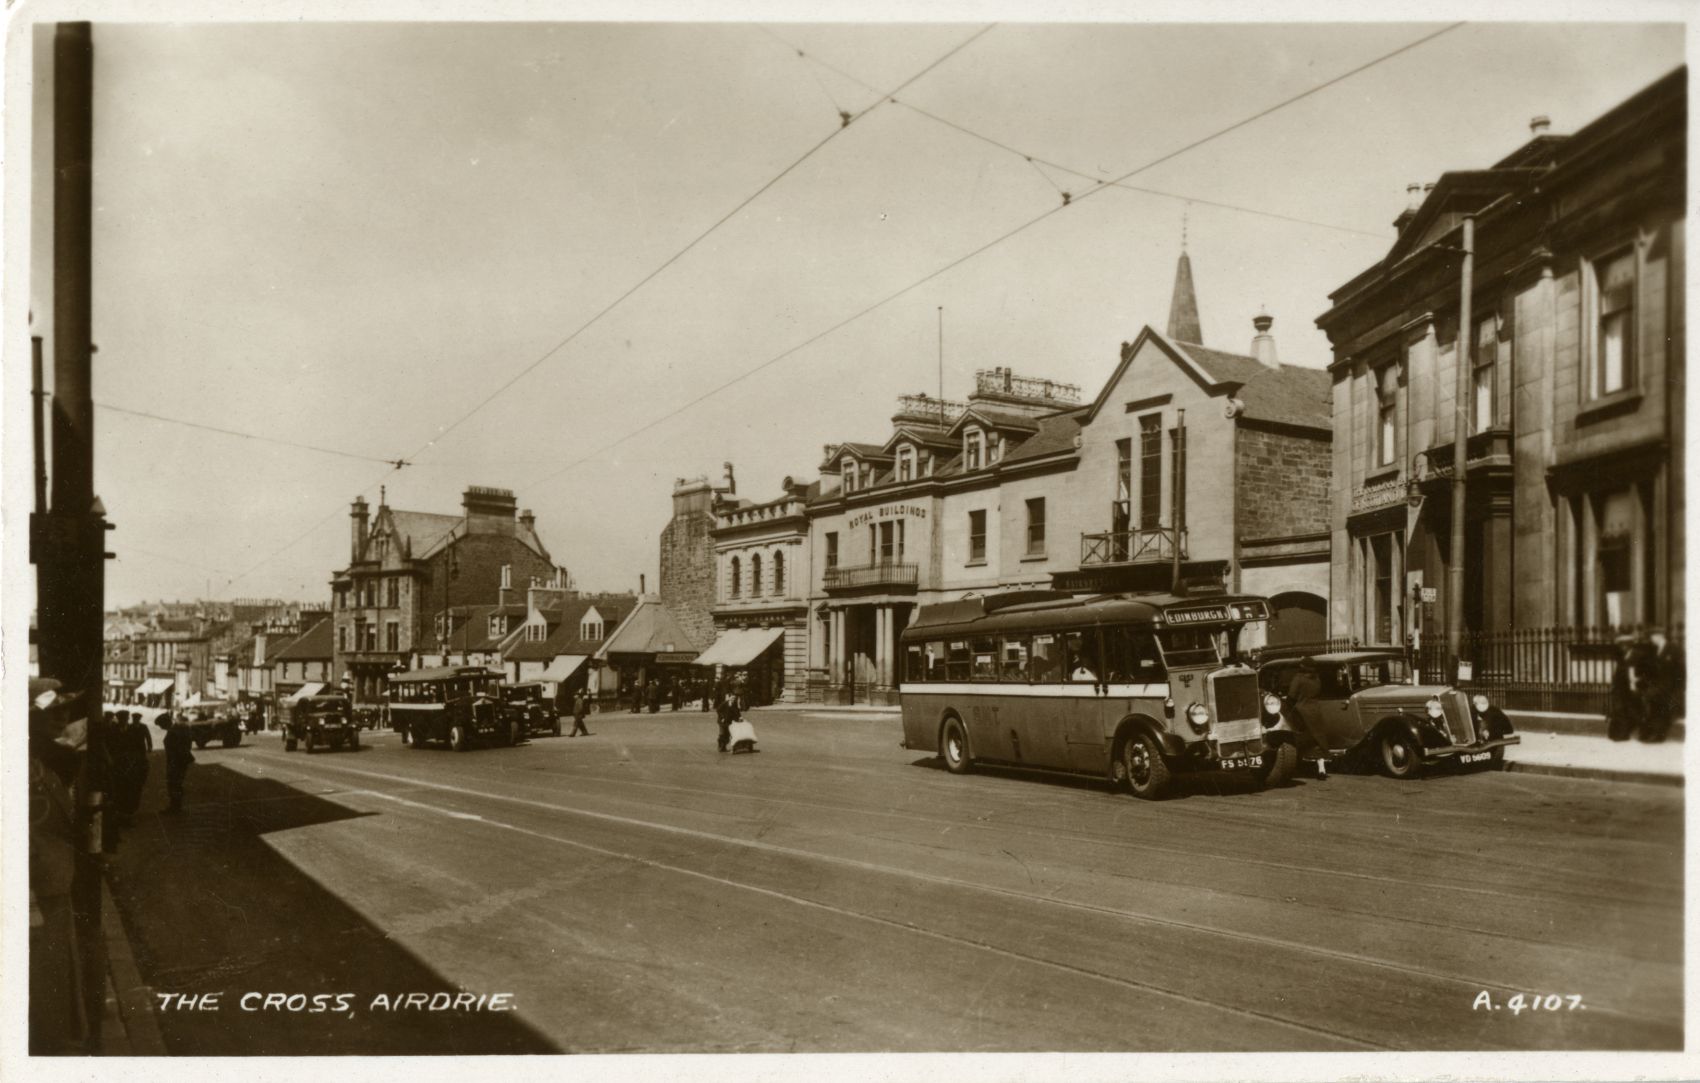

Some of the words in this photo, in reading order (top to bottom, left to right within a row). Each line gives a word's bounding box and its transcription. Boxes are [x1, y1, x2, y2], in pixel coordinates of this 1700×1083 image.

[849, 511, 873, 529] ROYAL
[879, 504, 926, 519] BUILDINGS
[1221, 759, 1235, 769] FS
